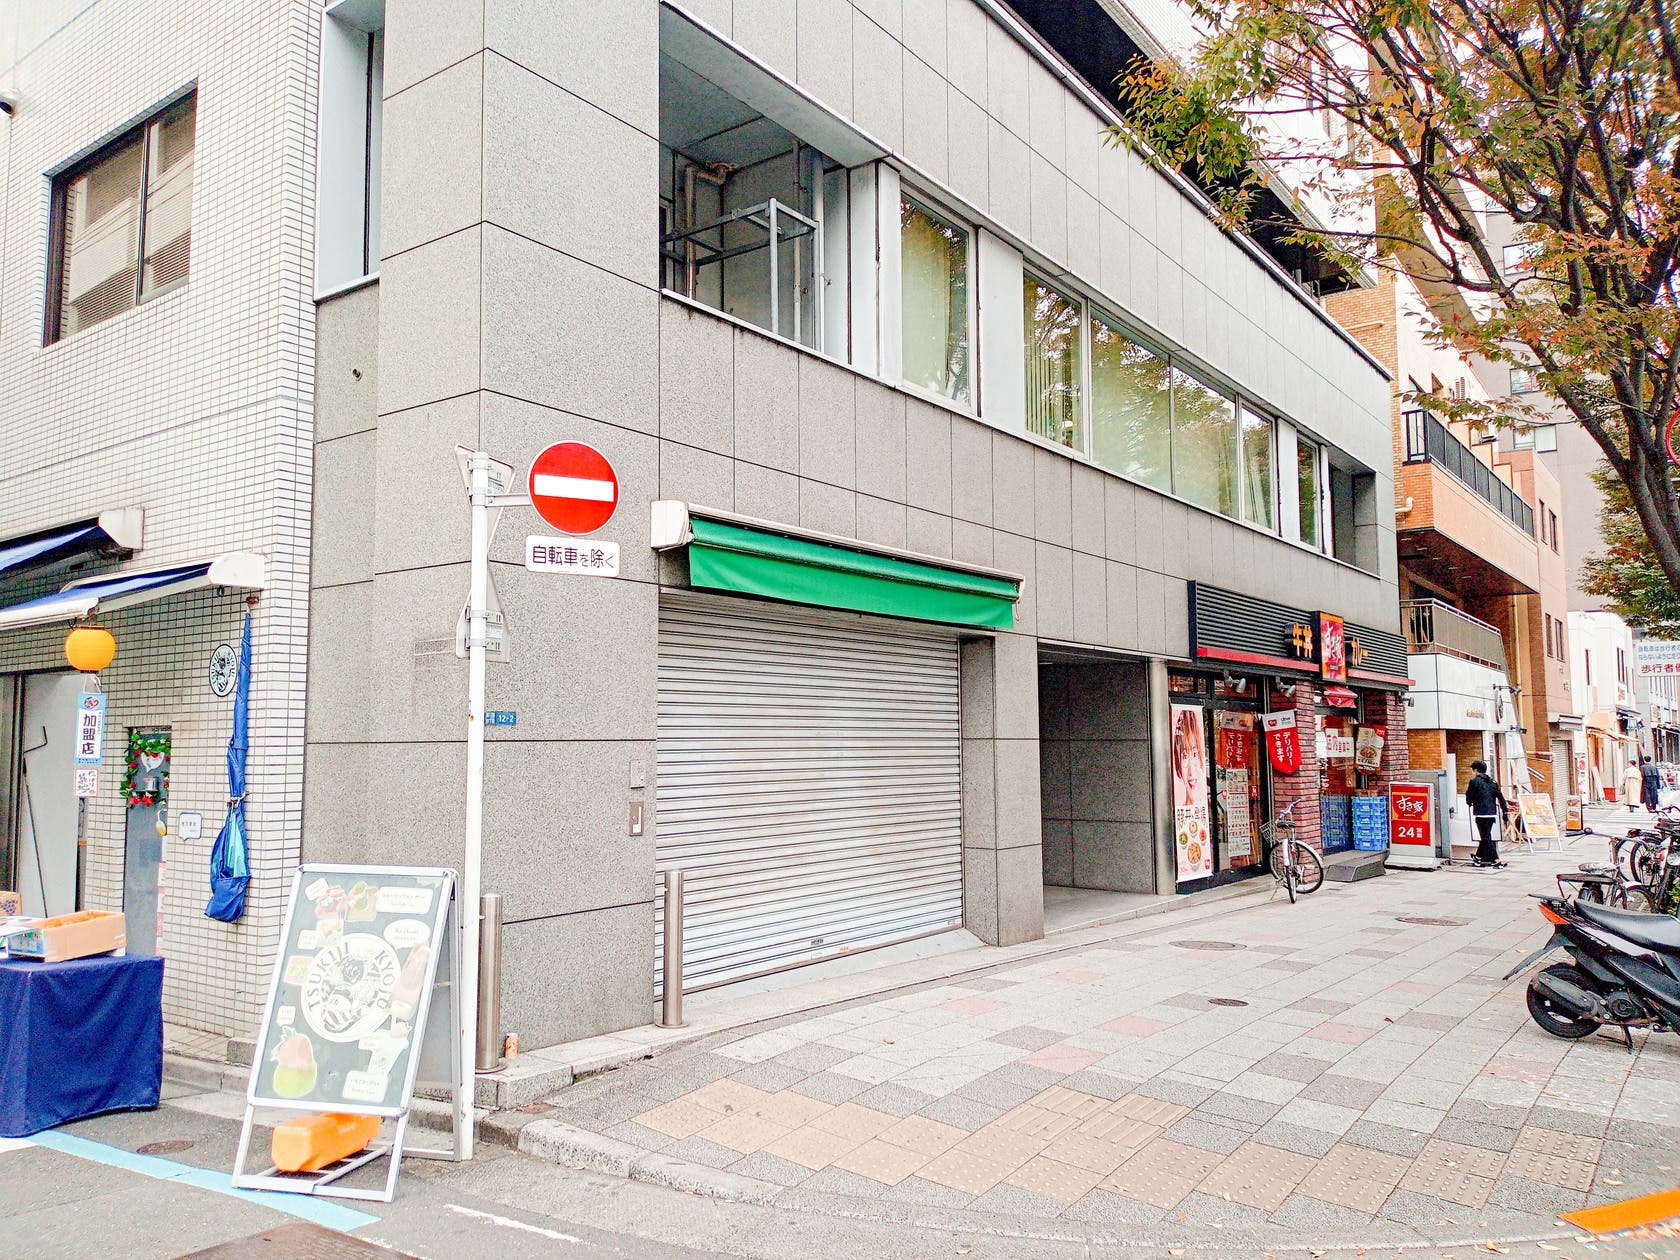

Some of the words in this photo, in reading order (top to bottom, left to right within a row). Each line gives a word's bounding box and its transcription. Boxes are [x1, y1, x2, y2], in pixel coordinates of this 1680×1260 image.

[533, 545, 614, 569] 自転車を除く
[498, 714, 514, 723] 12-2
[82, 714, 97, 755] 加盟店
[1396, 795, 1424, 813] すき家
[1398, 826, 1415, 838] 24
